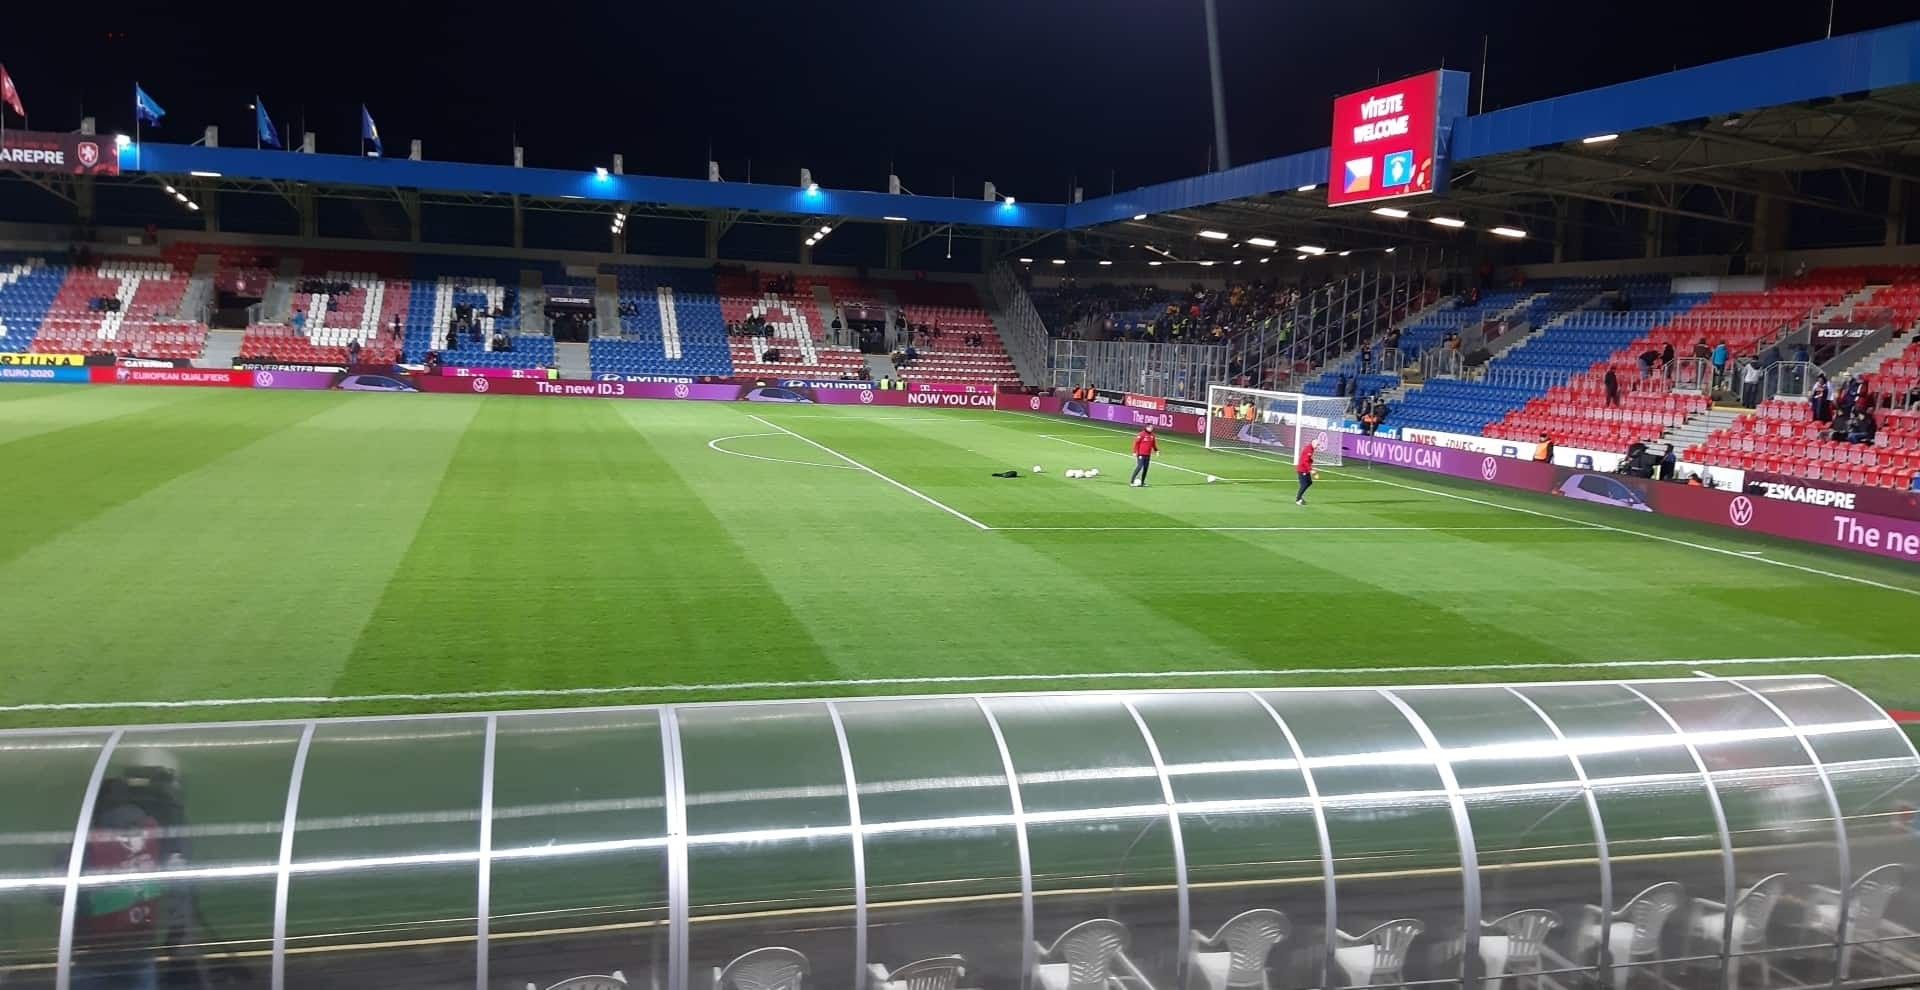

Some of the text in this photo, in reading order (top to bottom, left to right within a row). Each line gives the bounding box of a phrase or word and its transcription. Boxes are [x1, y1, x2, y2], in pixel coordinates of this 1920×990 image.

[1361, 93, 1405, 120] VÍTEJTE
[1353, 115, 1409, 144] WELCOME
[3, 368, 55, 378] EURO 2020
[133, 371, 230, 382] EUROPEAN QUALIFIERS
[537, 381, 625, 395] The new ID.3
[908, 393, 996, 406] NOW YOU CAN
[1132, 410, 1145, 423] The
[1356, 439, 1442, 469] NOW YOU CAN
[1834, 515, 1920, 555] The ne
